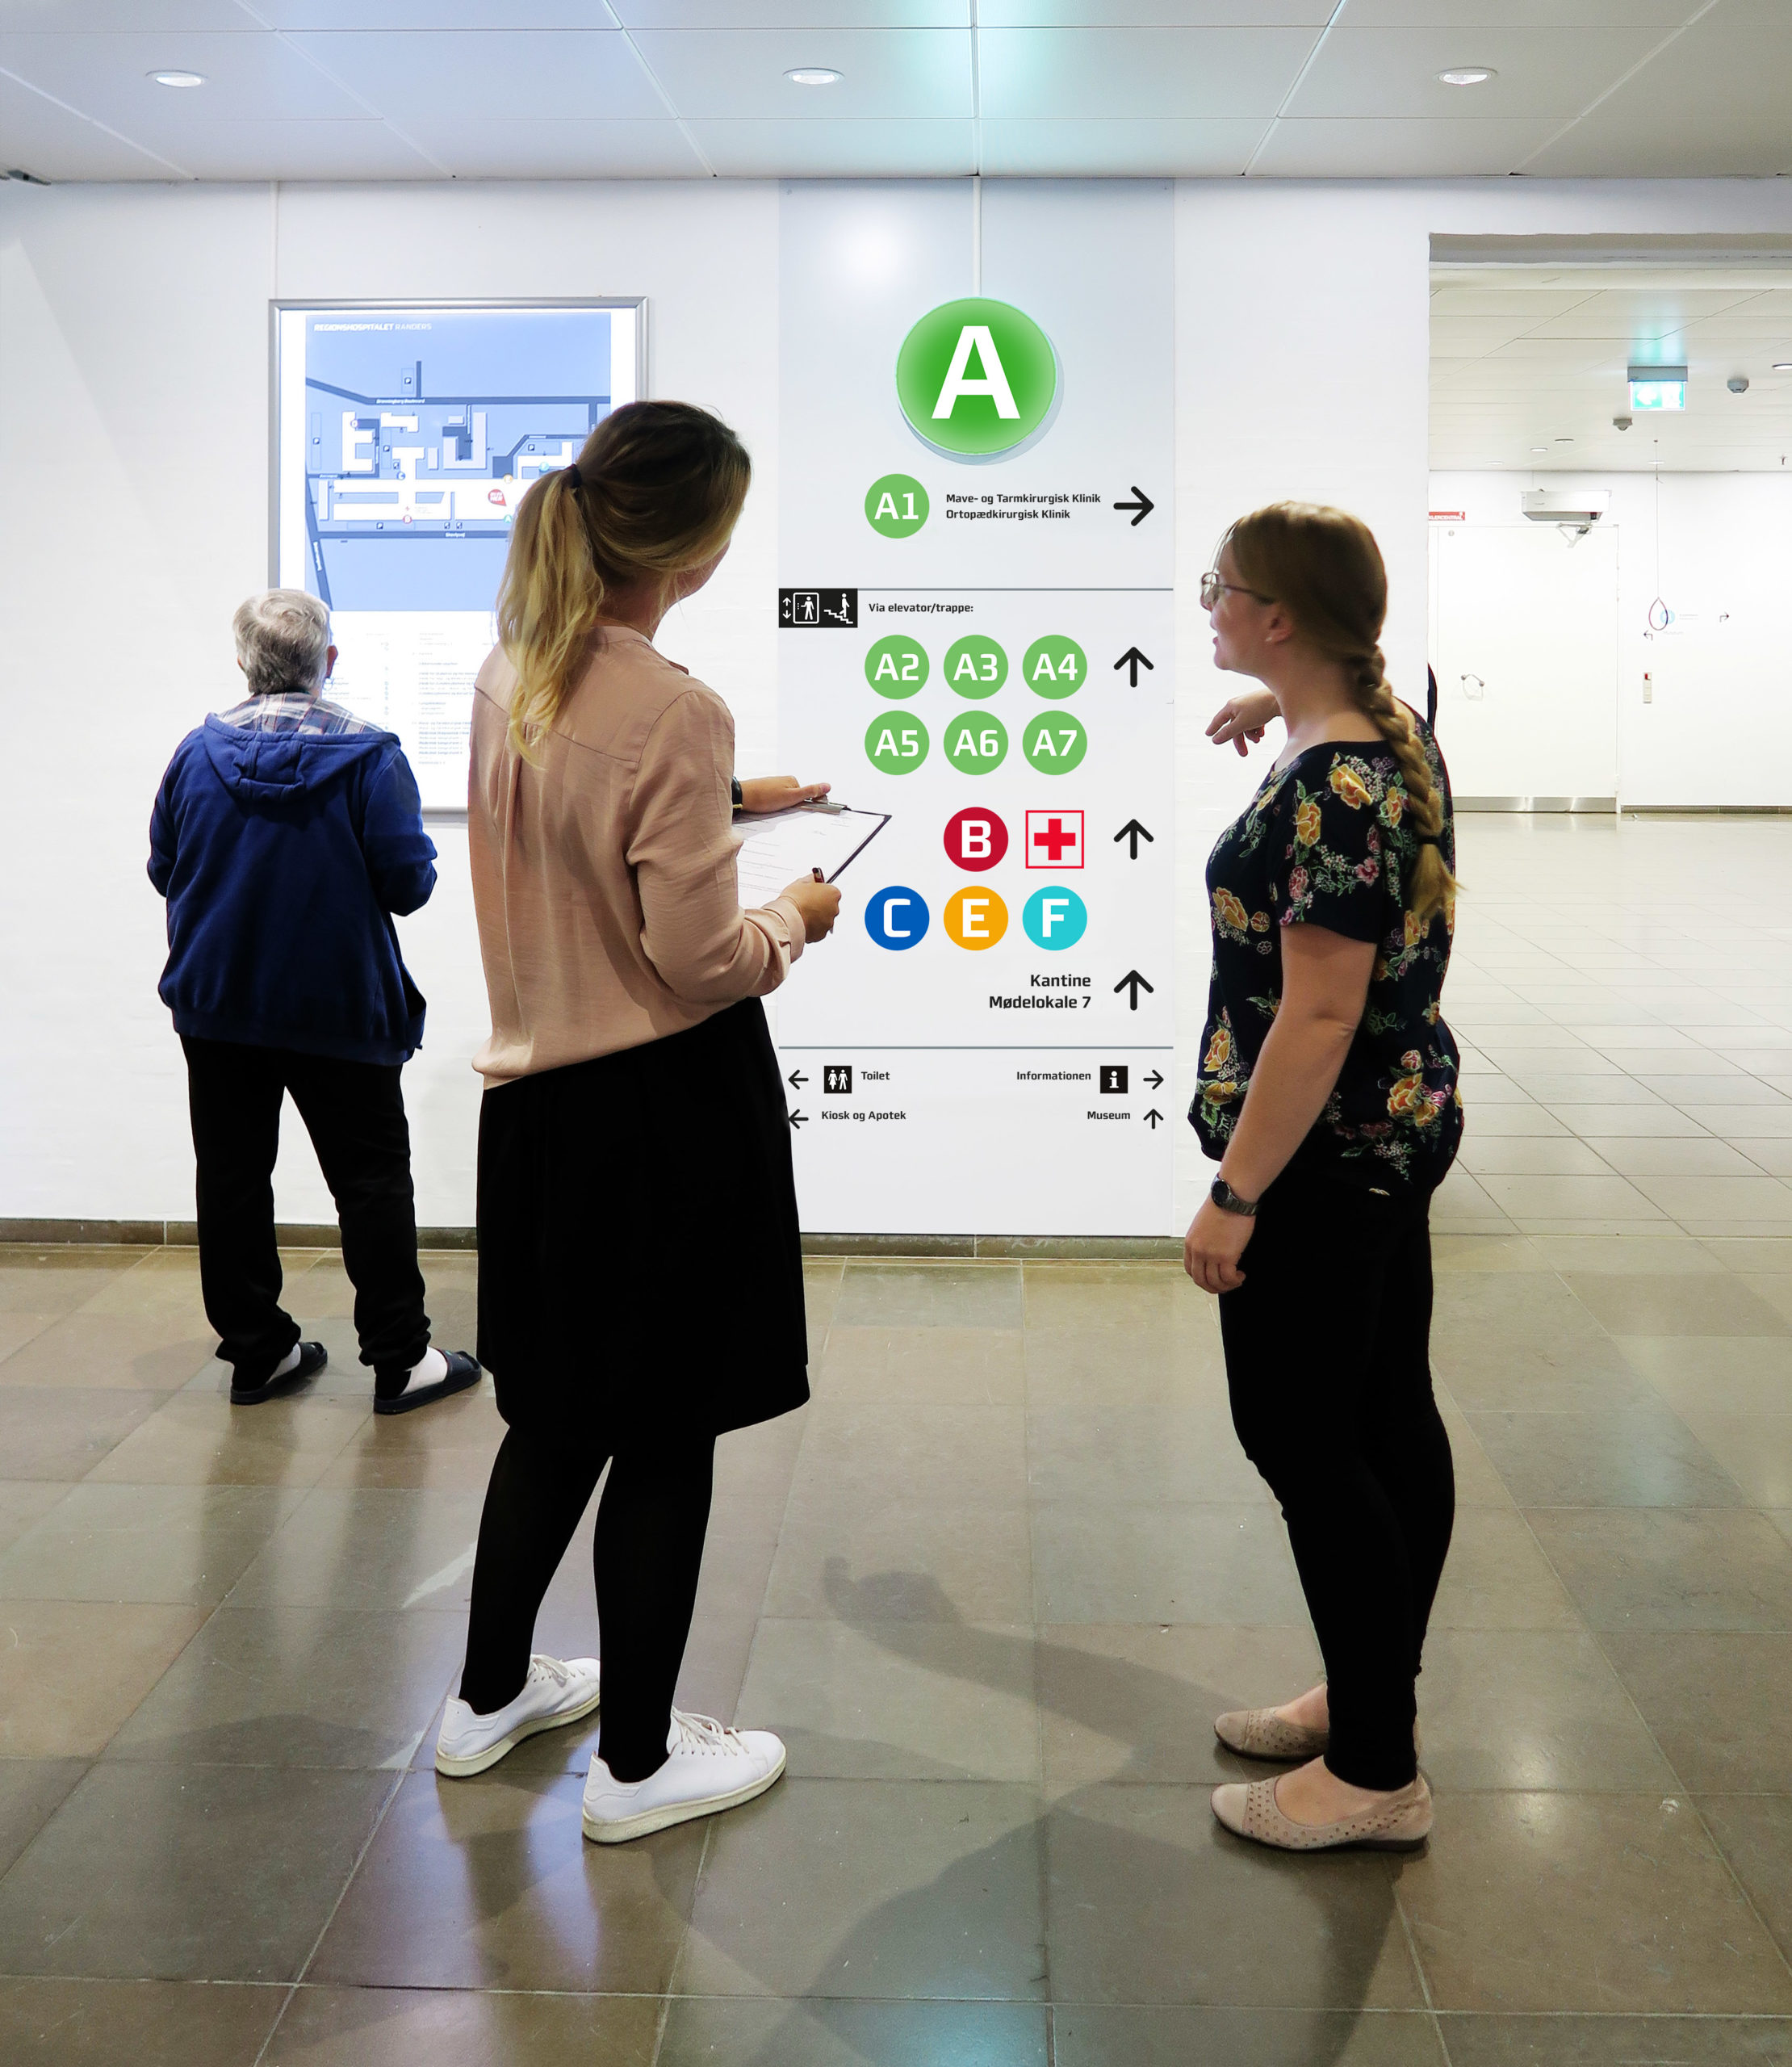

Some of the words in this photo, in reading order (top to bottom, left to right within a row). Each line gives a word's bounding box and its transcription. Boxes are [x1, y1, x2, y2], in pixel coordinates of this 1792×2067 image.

[314, 323, 394, 331] REGIONSHOSPITALET
[932, 326, 1020, 419] A
[947, 493, 978, 503] Mave-
[982, 497, 993, 505] og
[997, 493, 1070, 505] Tarmkirurgisk
[1073, 493, 1101, 503] Klinik
[875, 493, 918, 519] A1
[947, 509, 1039, 521] Ortopædkirurgisk
[1042, 509, 1070, 519] Klinik
[869, 602, 885, 613] Via
[889, 602, 973, 614] elevator/trappe:
[875, 654, 919, 681] A2
[954, 654, 998, 681] A3
[1032, 654, 1078, 681] A4
[875, 730, 919, 757] A5
[954, 730, 999, 757] A6
[1032, 730, 1077, 757] A7
[962, 821, 990, 857] B
[884, 899, 910, 937] C
[963, 899, 989, 937] E
[1043, 899, 1069, 937] F
[1031, 975, 1091, 987] Kantine
[989, 995, 1078, 1009] Mødelokale
[1082, 996, 1091, 1008] 7
[861, 1071, 890, 1080] Toilet
[1016, 1071, 1091, 1080] Informationen
[822, 1110, 850, 1120] Kiosk
[853, 1113, 865, 1122] og
[869, 1110, 906, 1122] Apotek
[1087, 1110, 1131, 1120] Museum
